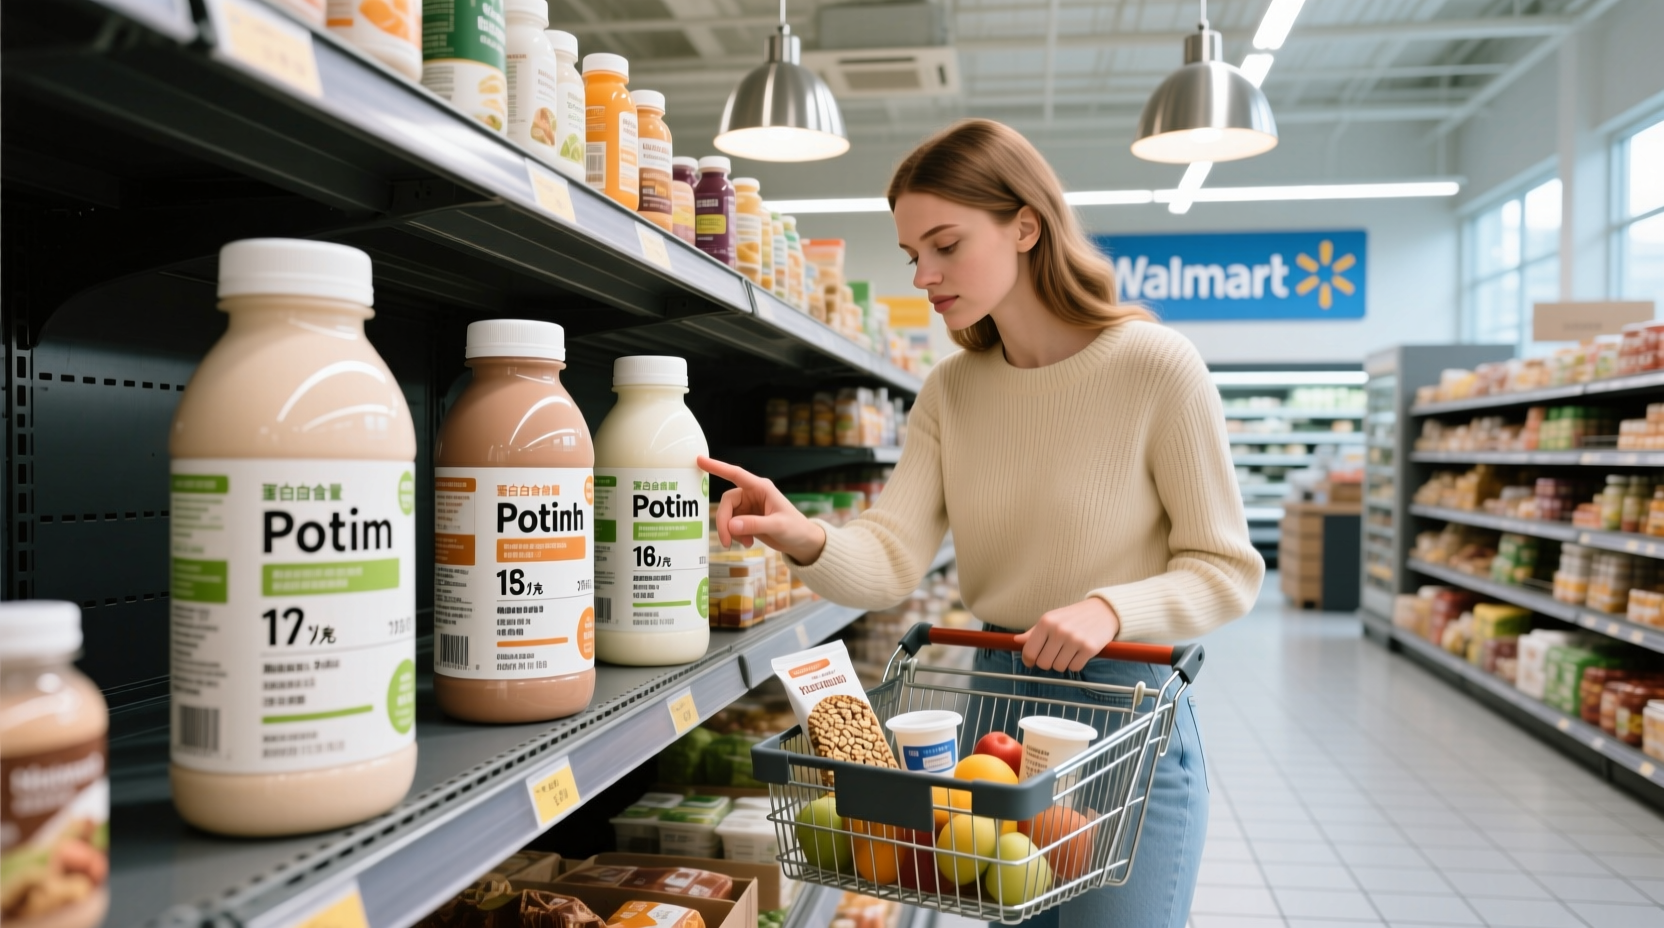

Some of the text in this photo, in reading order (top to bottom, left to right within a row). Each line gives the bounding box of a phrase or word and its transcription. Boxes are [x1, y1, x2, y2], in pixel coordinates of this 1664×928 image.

[1115, 253, 1290, 299] Walmart
[632, 493, 699, 518] Potim
[263, 507, 392, 553] Potim
